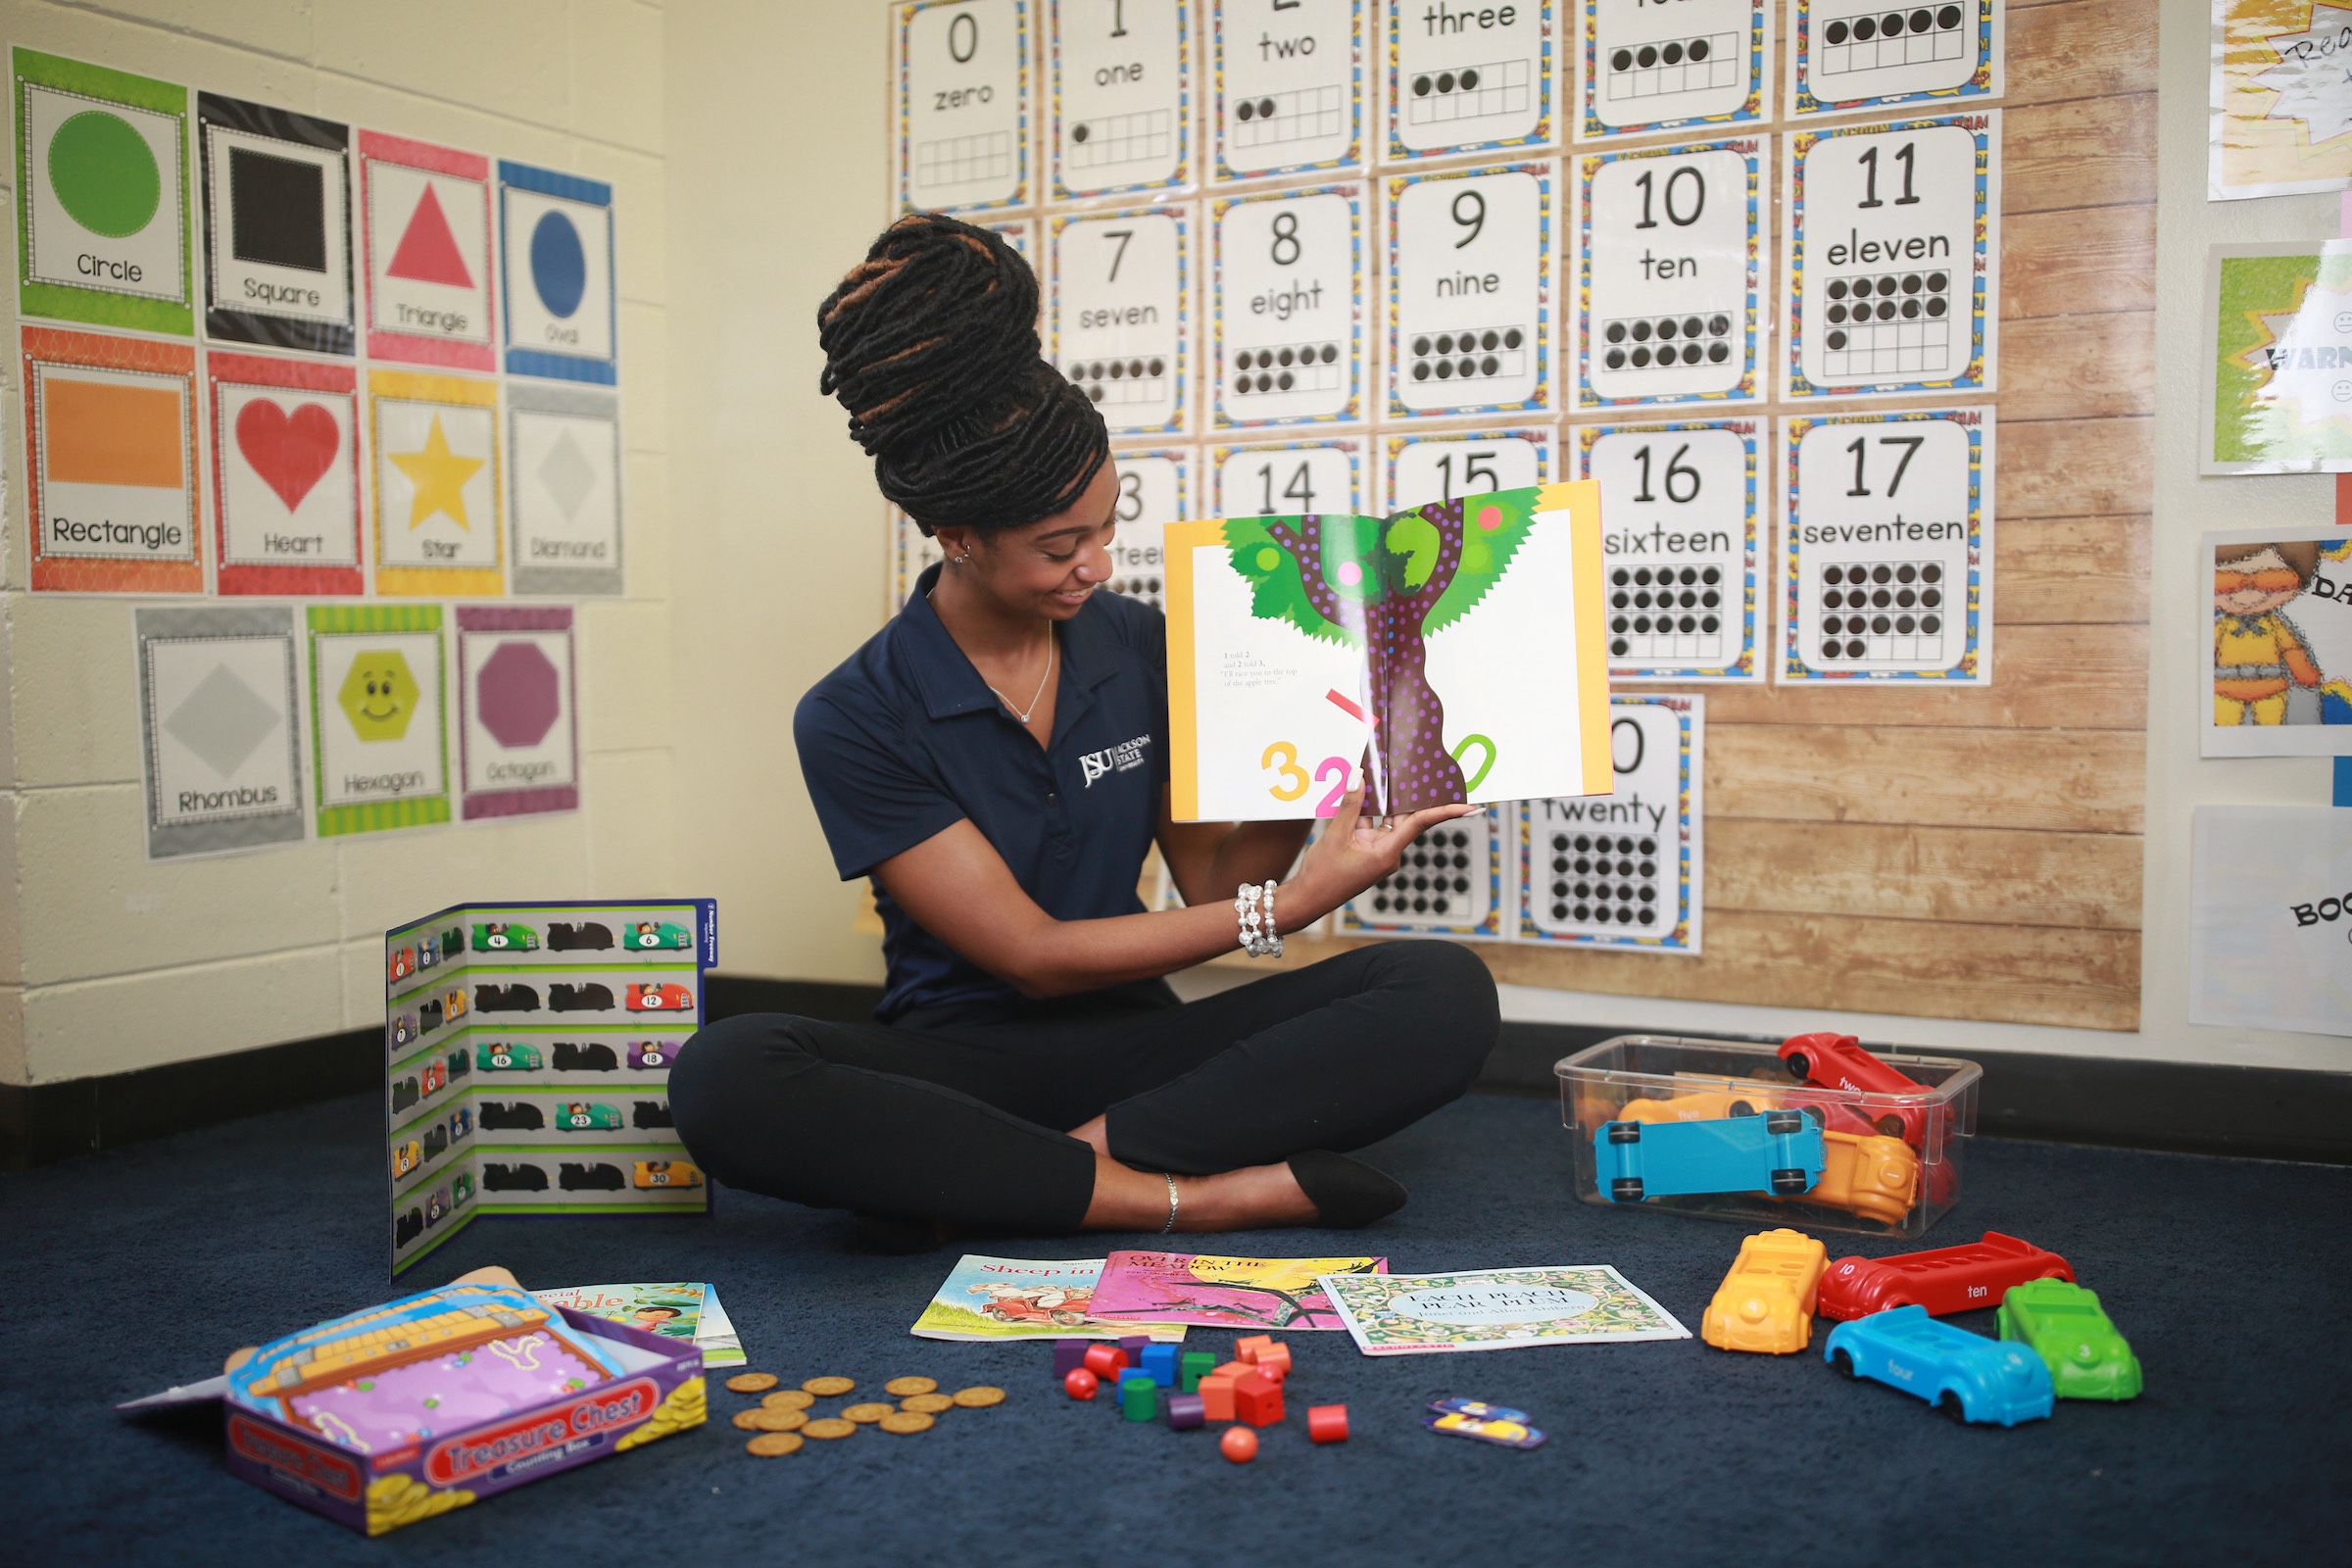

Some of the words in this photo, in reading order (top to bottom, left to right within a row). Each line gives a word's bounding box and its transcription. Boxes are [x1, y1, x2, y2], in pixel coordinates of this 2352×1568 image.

[1423, 4, 1517, 37] three
[949, 13, 978, 64] 0
[1259, 32, 1316, 62] two
[1095, 62, 1144, 86] one
[934, 83, 994, 111] zero
[1858, 141, 1921, 209] 11
[1635, 166, 1706, 230] 10
[1451, 189, 1486, 249] 9
[1270, 211, 1300, 266] 8
[1827, 228, 1950, 266] eleven
[76, 253, 143, 283] Circle
[1102, 230, 1133, 282] 7
[1640, 248, 1697, 281] ten
[243, 277, 320, 308] Square
[1437, 269, 1500, 298] nine
[1250, 279, 1323, 320] eight
[395, 303, 468, 333] Triangle
[1080, 301, 1157, 329] seven
[1437, 451, 1498, 501] 15
[1634, 443, 1701, 504] 16
[1846, 436, 1925, 498] 17
[1257, 460, 1316, 514] 14
[53, 517, 182, 549] Rectangle
[1604, 521, 1731, 555] sixteen
[1804, 514, 1964, 545] seventeen
[265, 533, 323, 555] Heart
[422, 539, 462, 559] Star
[1246, 678, 1261, 688] apple
[1079, 748, 1114, 788] JSU
[1117, 748, 1142, 764] STATE
[343, 770, 424, 794] Hexagon
[486, 760, 556, 782] Octagon
[1261, 741, 1309, 802] 3
[178, 785, 278, 814] Rhombus
[1314, 757, 1352, 818] 2
[1542, 794, 1667, 833] twenty
[494, 936, 502, 946] 4
[646, 935, 653, 945] 6
[648, 996, 658, 1005] 12
[497, 1055, 507, 1065] 16
[648, 1054, 658, 1063] 18
[1839, 1077, 1862, 1093] two
[574, 1115, 587, 1125] 23
[1678, 1109, 1699, 1120] five
[652, 1174, 666, 1184] 30
[980, 1263, 1060, 1277] Sheep
[1129, 1261, 1231, 1271] MEADOW
[1130, 1255, 1187, 1264] OVER
[1839, 1263, 1855, 1275] 10
[536, 1290, 580, 1298] ecial
[553, 1294, 624, 1308] able
[1422, 1300, 1486, 1309] PEAR
[1501, 1298, 1569, 1306] PLUM
[1489, 1290, 1568, 1298] PEACH
[1968, 1285, 1987, 1298] ten
[1748, 1301, 1757, 1313] 9
[2080, 1344, 2090, 1357] 3
[449, 1421, 565, 1472] Treasure
[572, 1392, 641, 1431] Chest
[505, 1446, 564, 1474] Counting
[566, 1439, 591, 1454] Box
